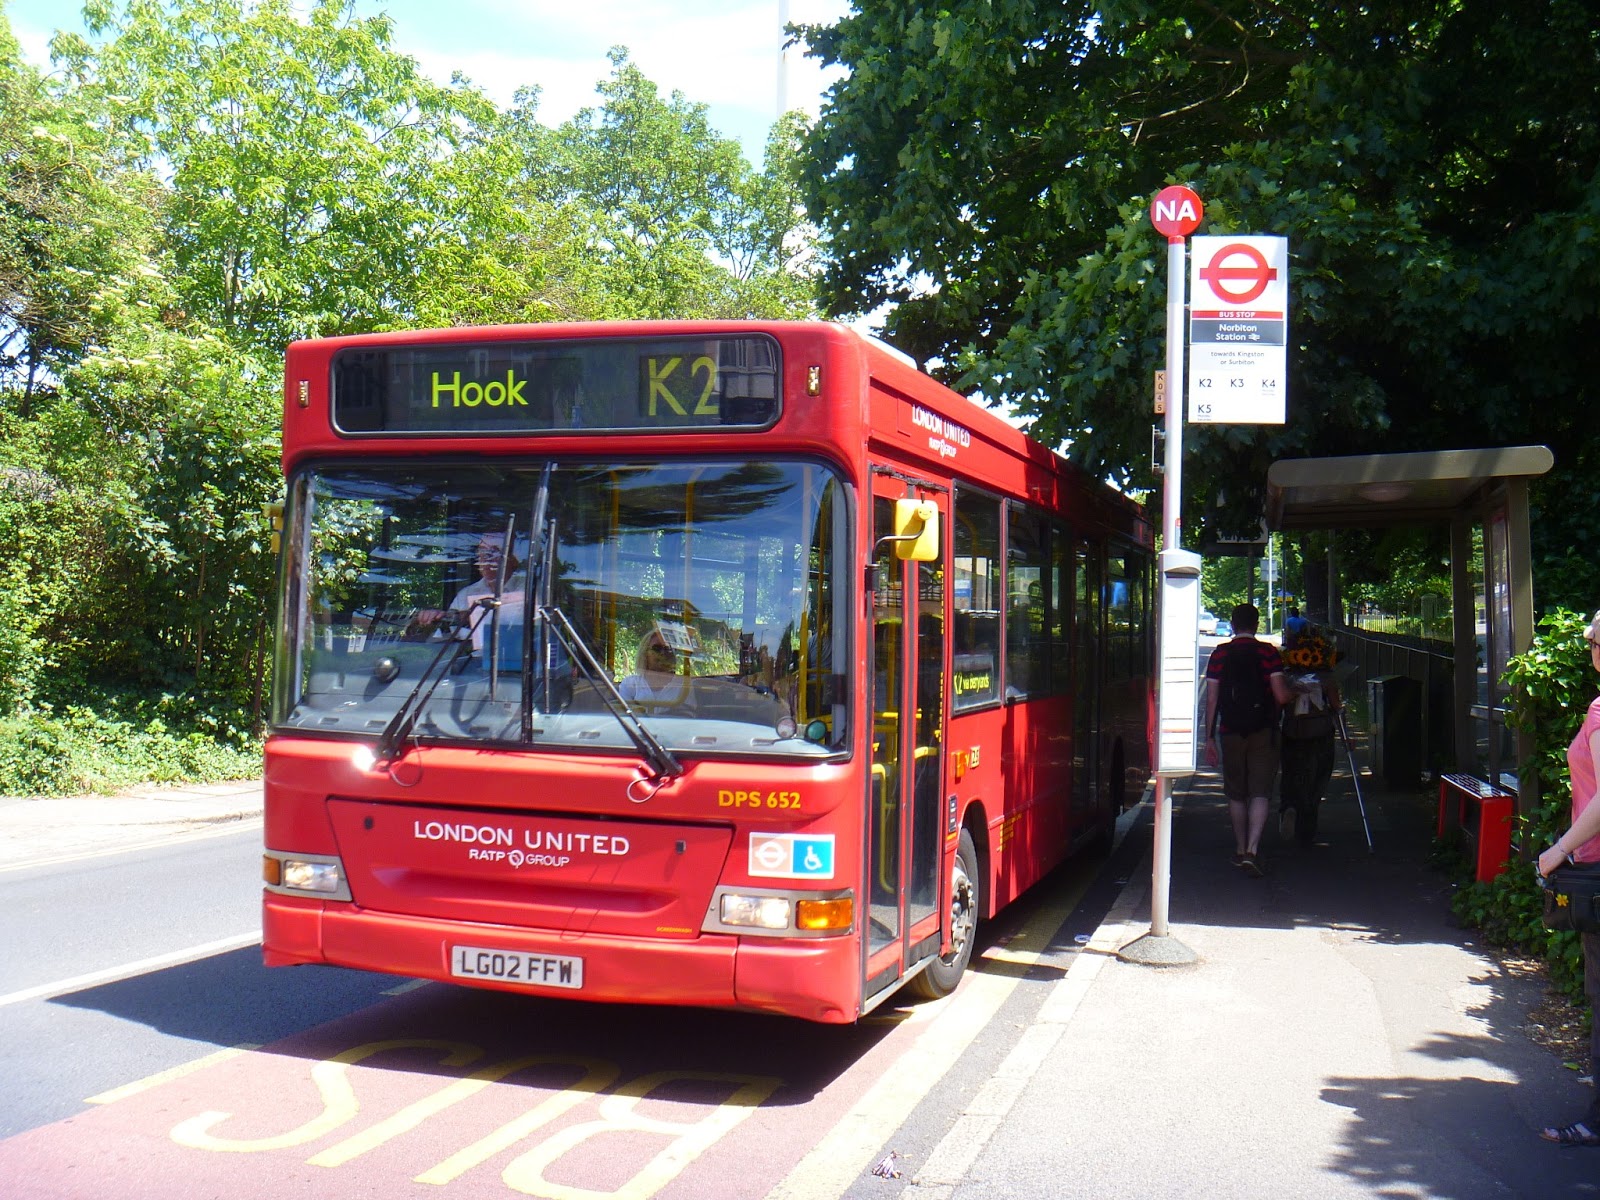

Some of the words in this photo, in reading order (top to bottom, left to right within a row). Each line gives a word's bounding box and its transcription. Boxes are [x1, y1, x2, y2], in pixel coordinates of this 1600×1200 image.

[1155, 200, 1197, 222] NA
[1215, 333, 1247, 341] Station
[1219, 323, 1257, 332] Norbiton
[432, 370, 529, 408] Hook
[648, 356, 720, 416] K2
[1198, 378, 1212, 388] K2
[1230, 378, 1245, 388] K3
[1261, 379, 1276, 388] K4
[1197, 404, 1212, 414] K5
[912, 404, 943, 435] LONDON
[944, 420, 970, 448] UNITED
[718, 790, 762, 808] DPS
[766, 791, 801, 809] 652
[414, 821, 513, 847] LONDON
[524, 829, 630, 856] UNITED
[468, 848, 506, 862] RATP
[525, 853, 570, 867] GROUP
[461, 950, 521, 979] LG02
[527, 957, 573, 984] FFW
[170, 1038, 787, 1200] BUS
